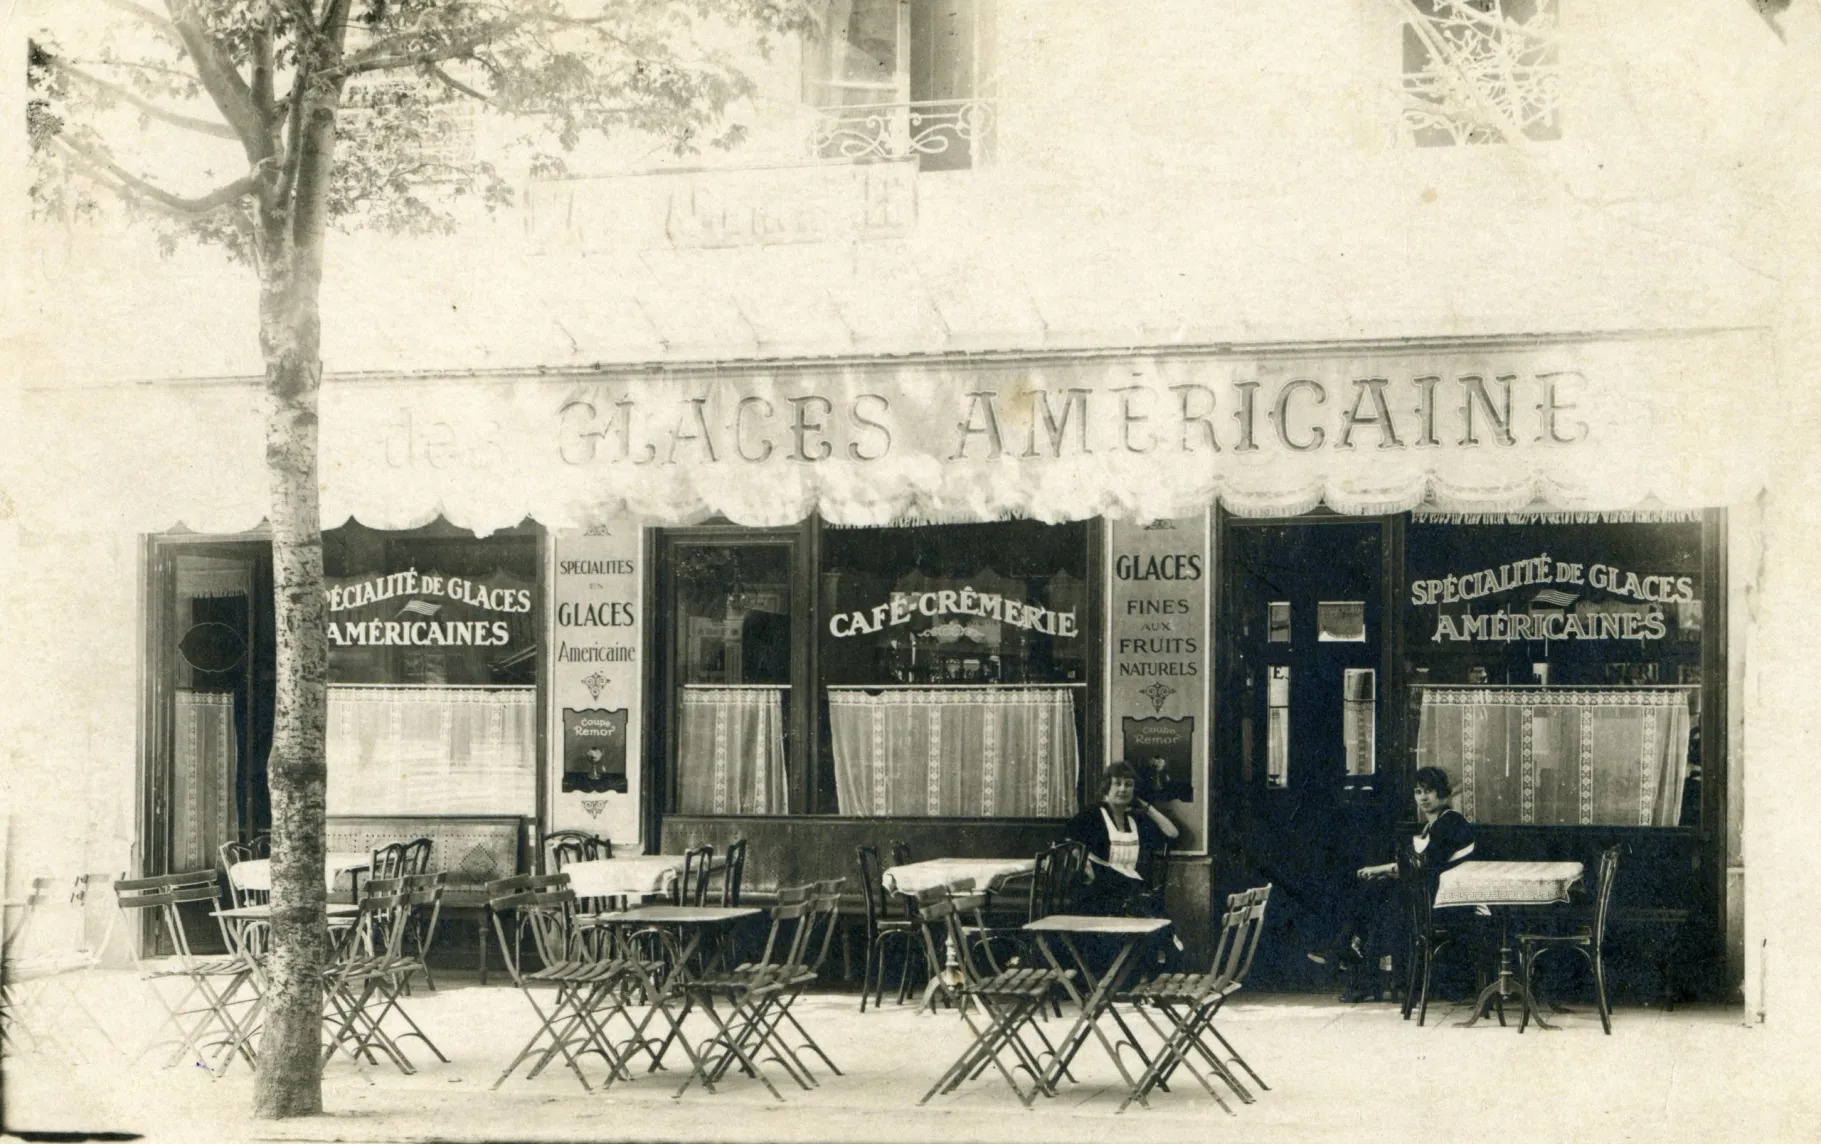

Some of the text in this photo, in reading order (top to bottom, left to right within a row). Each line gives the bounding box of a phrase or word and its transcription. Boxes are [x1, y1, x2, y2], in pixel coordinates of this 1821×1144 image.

[558, 393, 893, 464] GLACES
[1116, 554, 1202, 581] GLACES
[1411, 552, 1694, 606] SPÉCIALITÉ DE GLACES
[422, 575, 445, 596] DE
[448, 577, 531, 613] GLACES
[1127, 599, 1190, 615] FINES
[558, 602, 634, 627] GLACES
[829, 586, 1079, 638] CAFÉ-CRÊMERIE
[1431, 609, 1667, 642] AMÉRICAINES
[327, 617, 510, 647] AMÉRICAINES
[1140, 622, 1171, 632] AUX
[558, 640, 637, 663] Americaine
[1119, 637, 1198, 654] FRUITS
[1119, 661, 1198, 677] NATURELS
